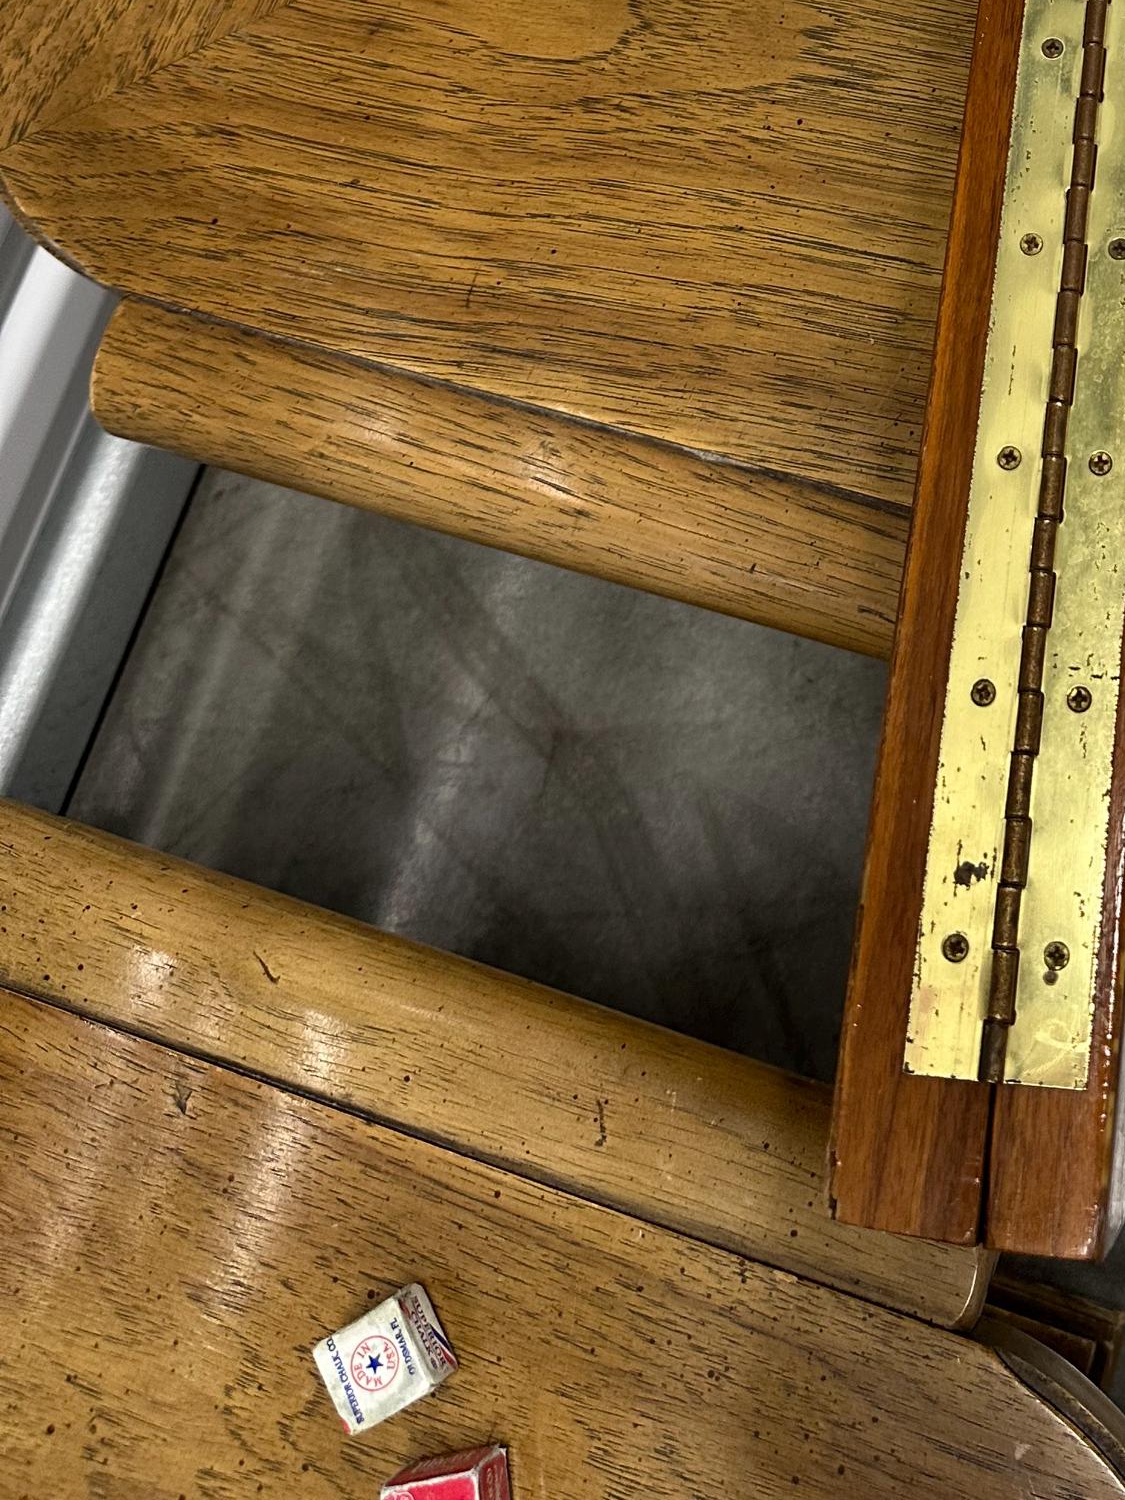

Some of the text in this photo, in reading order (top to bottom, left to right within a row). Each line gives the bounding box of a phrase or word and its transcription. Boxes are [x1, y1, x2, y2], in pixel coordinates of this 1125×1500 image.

[410, 1309, 433, 1356] CHALK
[413, 1295, 448, 1368] SUPERIOR
[353, 1341, 384, 1387] MADE IN
[343, 1382, 365, 1425] SUPERIOR
